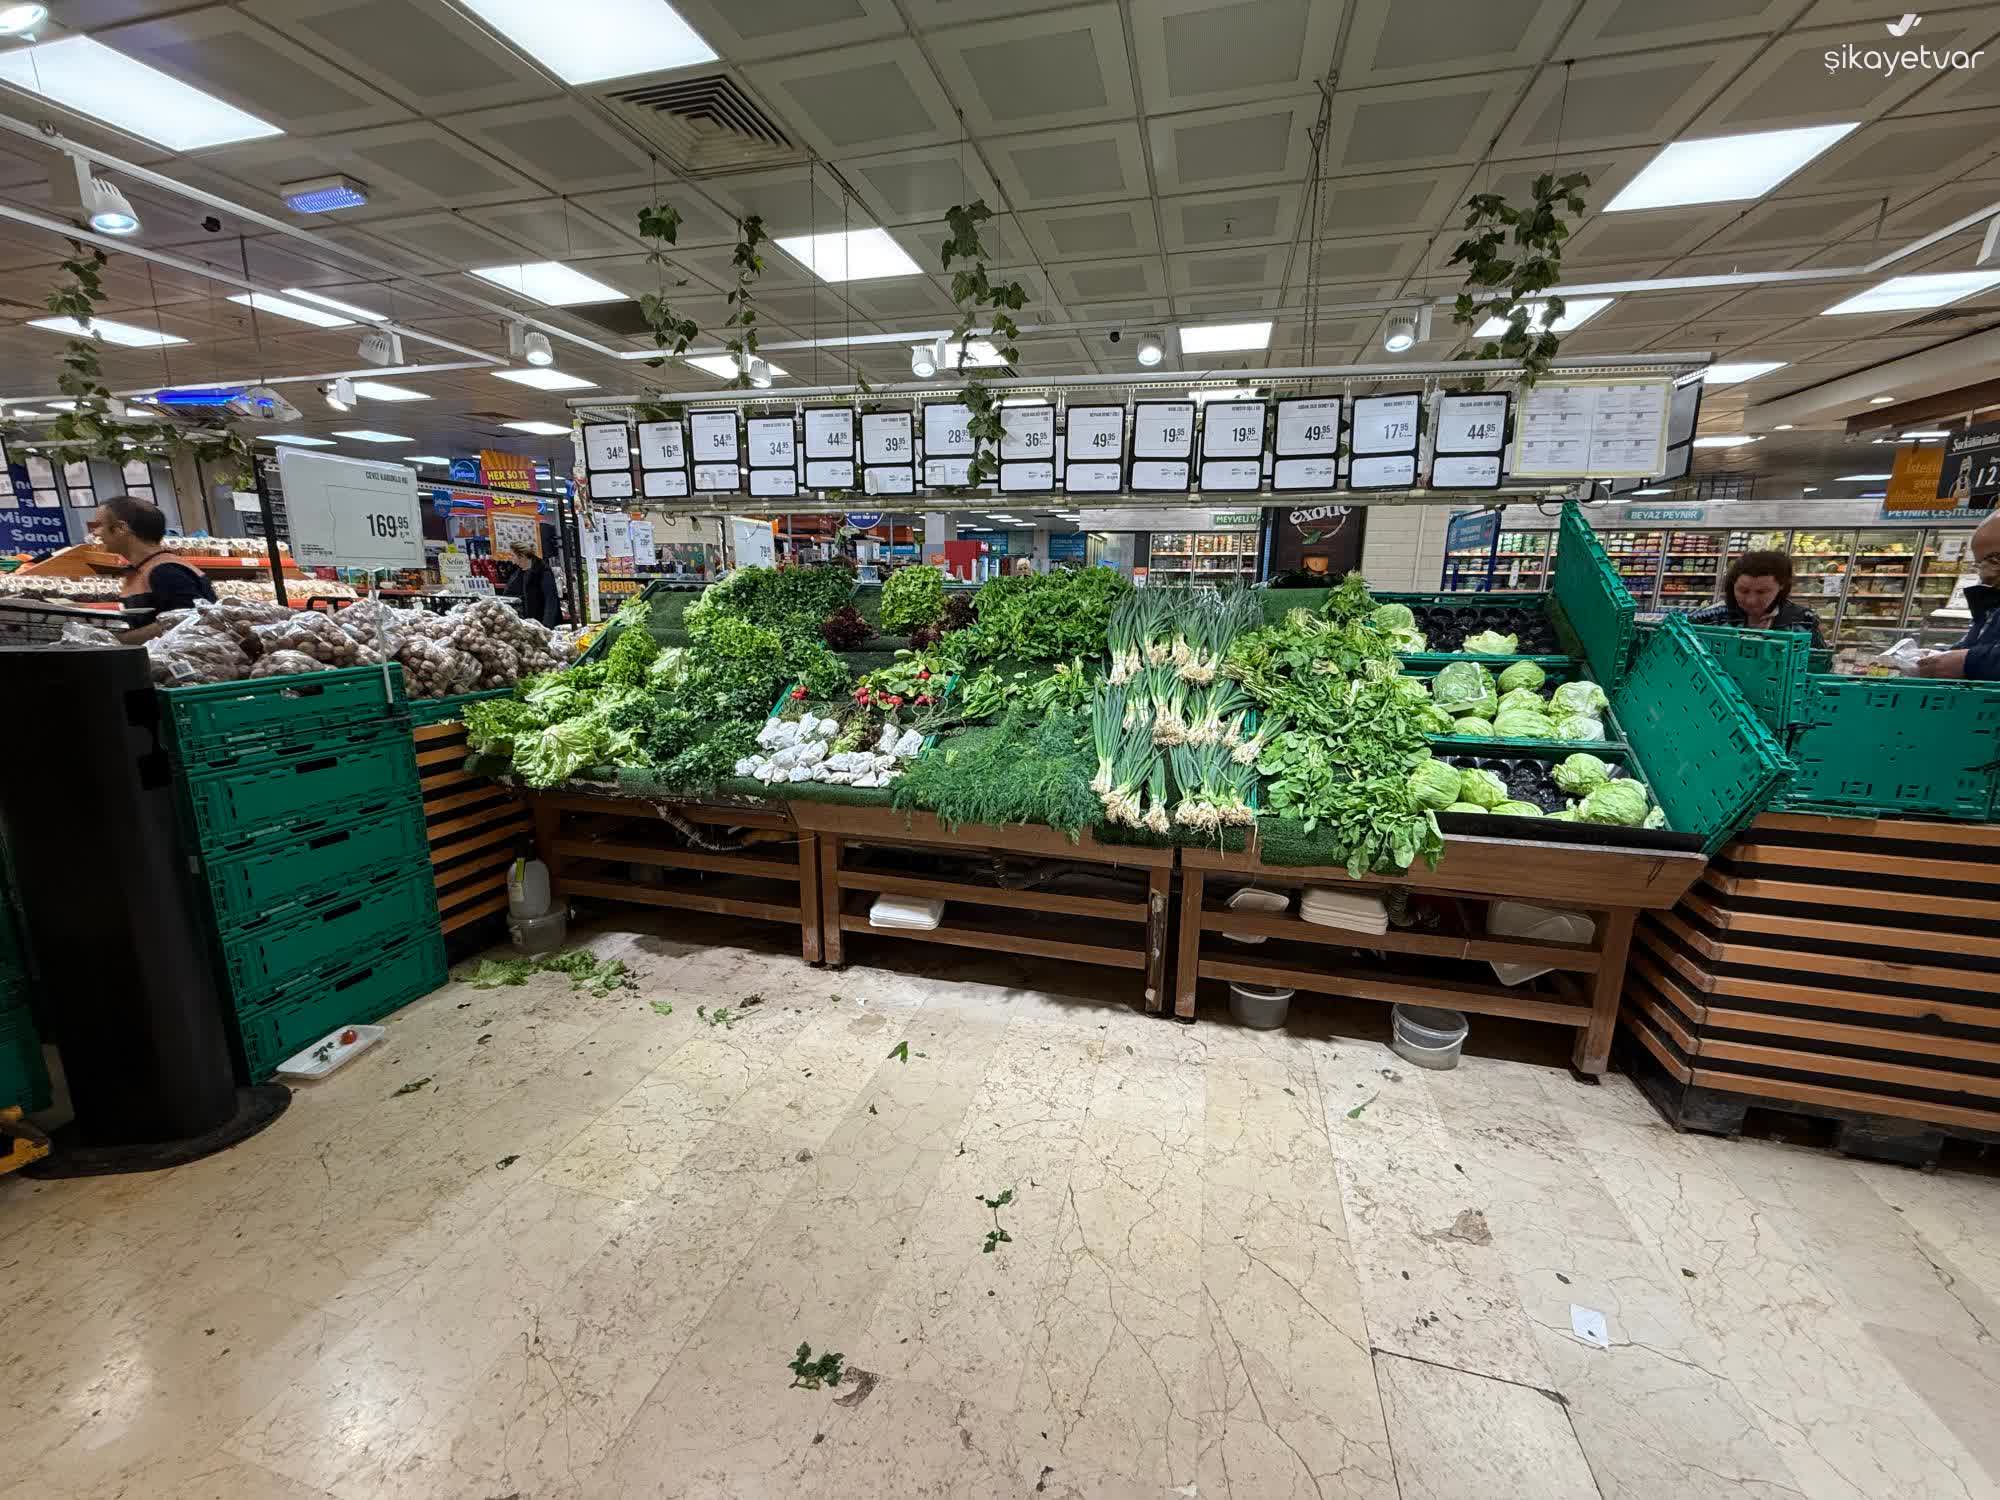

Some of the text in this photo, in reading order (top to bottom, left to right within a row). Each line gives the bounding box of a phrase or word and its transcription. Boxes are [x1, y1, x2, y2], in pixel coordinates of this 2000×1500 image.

[0, 511, 62, 528] Migros
[1631, 511, 1660, 519] BEYAZ
[11, 528, 65, 543] Sanal
